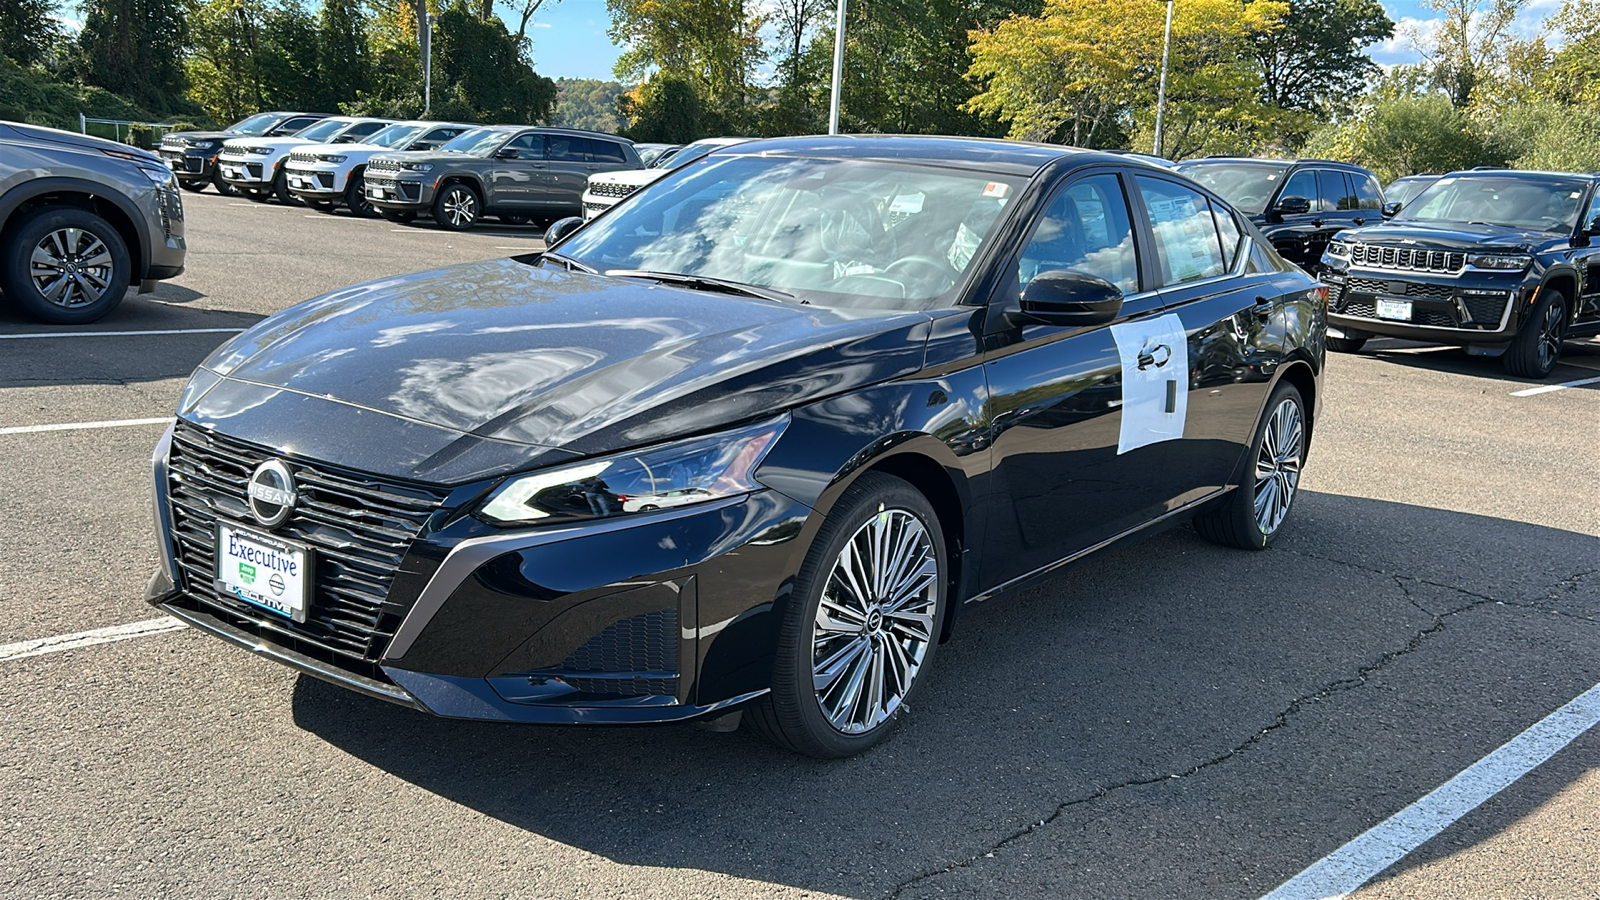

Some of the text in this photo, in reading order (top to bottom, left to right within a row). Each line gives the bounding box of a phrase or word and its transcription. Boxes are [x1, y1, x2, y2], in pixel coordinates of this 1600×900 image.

[249, 484, 295, 505] NISSAN
[228, 534, 297, 577] Executive
[241, 564, 255, 576] Jeep
[226, 583, 292, 614] EXECUTIVE
